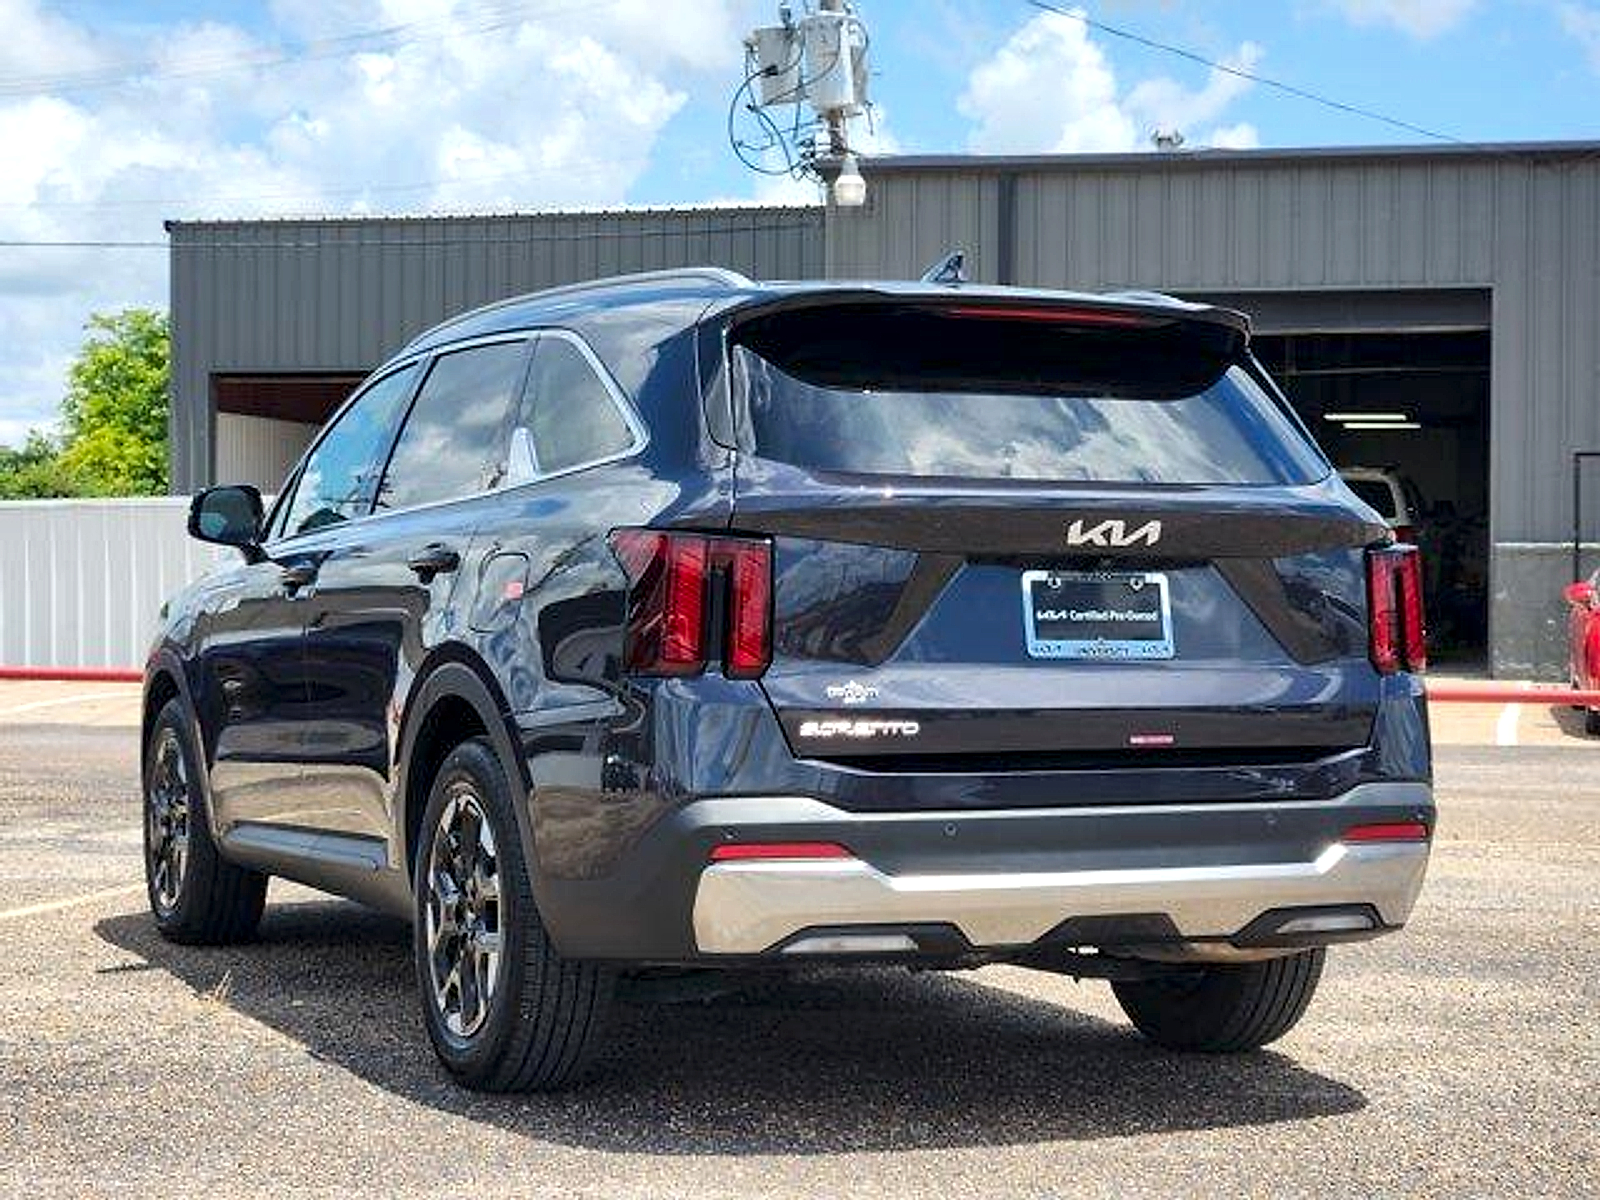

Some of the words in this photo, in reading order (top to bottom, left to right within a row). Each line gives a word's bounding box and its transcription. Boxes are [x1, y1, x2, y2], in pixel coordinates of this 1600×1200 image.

[1067, 519, 1162, 547] KIA
[1070, 610, 1108, 622] Certified
[799, 721, 920, 737] SORENTO
